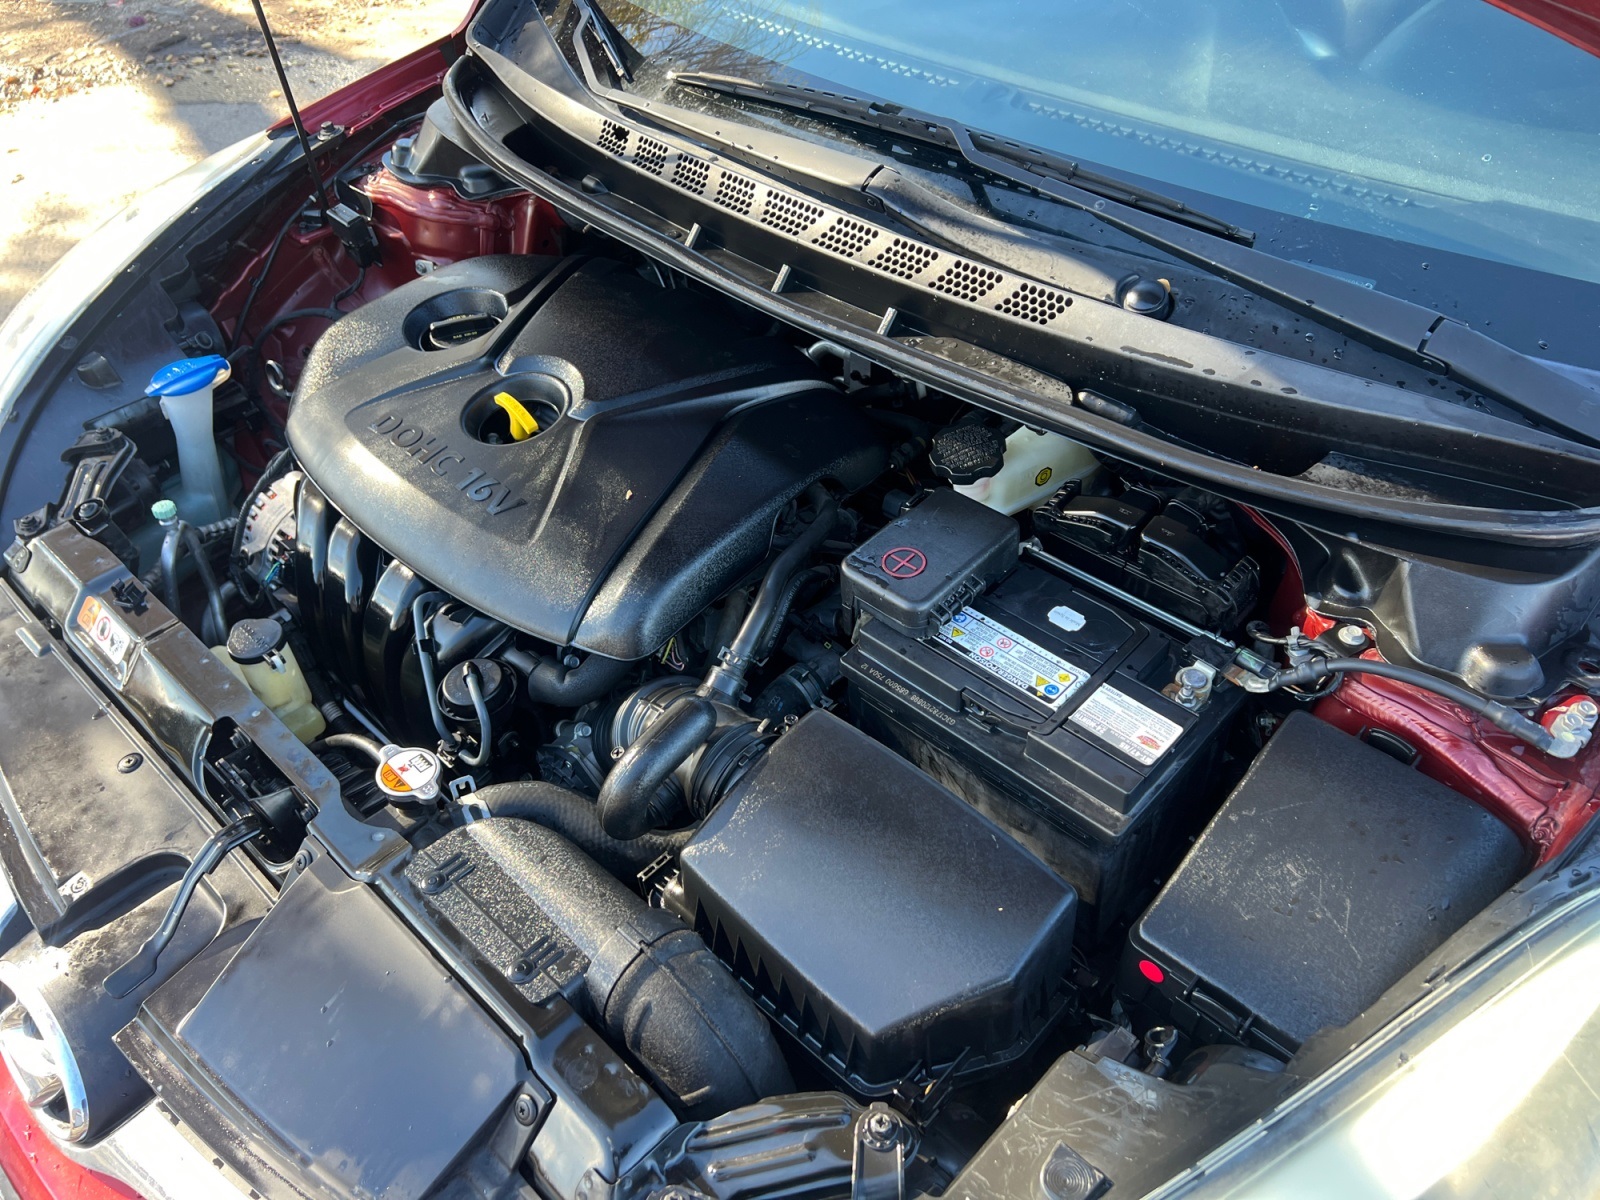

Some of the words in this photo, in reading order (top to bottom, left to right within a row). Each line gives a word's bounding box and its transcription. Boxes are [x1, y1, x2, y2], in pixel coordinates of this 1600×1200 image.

[367, 410, 466, 478] DOHC
[453, 465, 528, 516] 16V
[859, 661, 869, 670] 12
[867, 666, 886, 681] 750A
[967, 650, 1029, 690] DANGER/POISON
